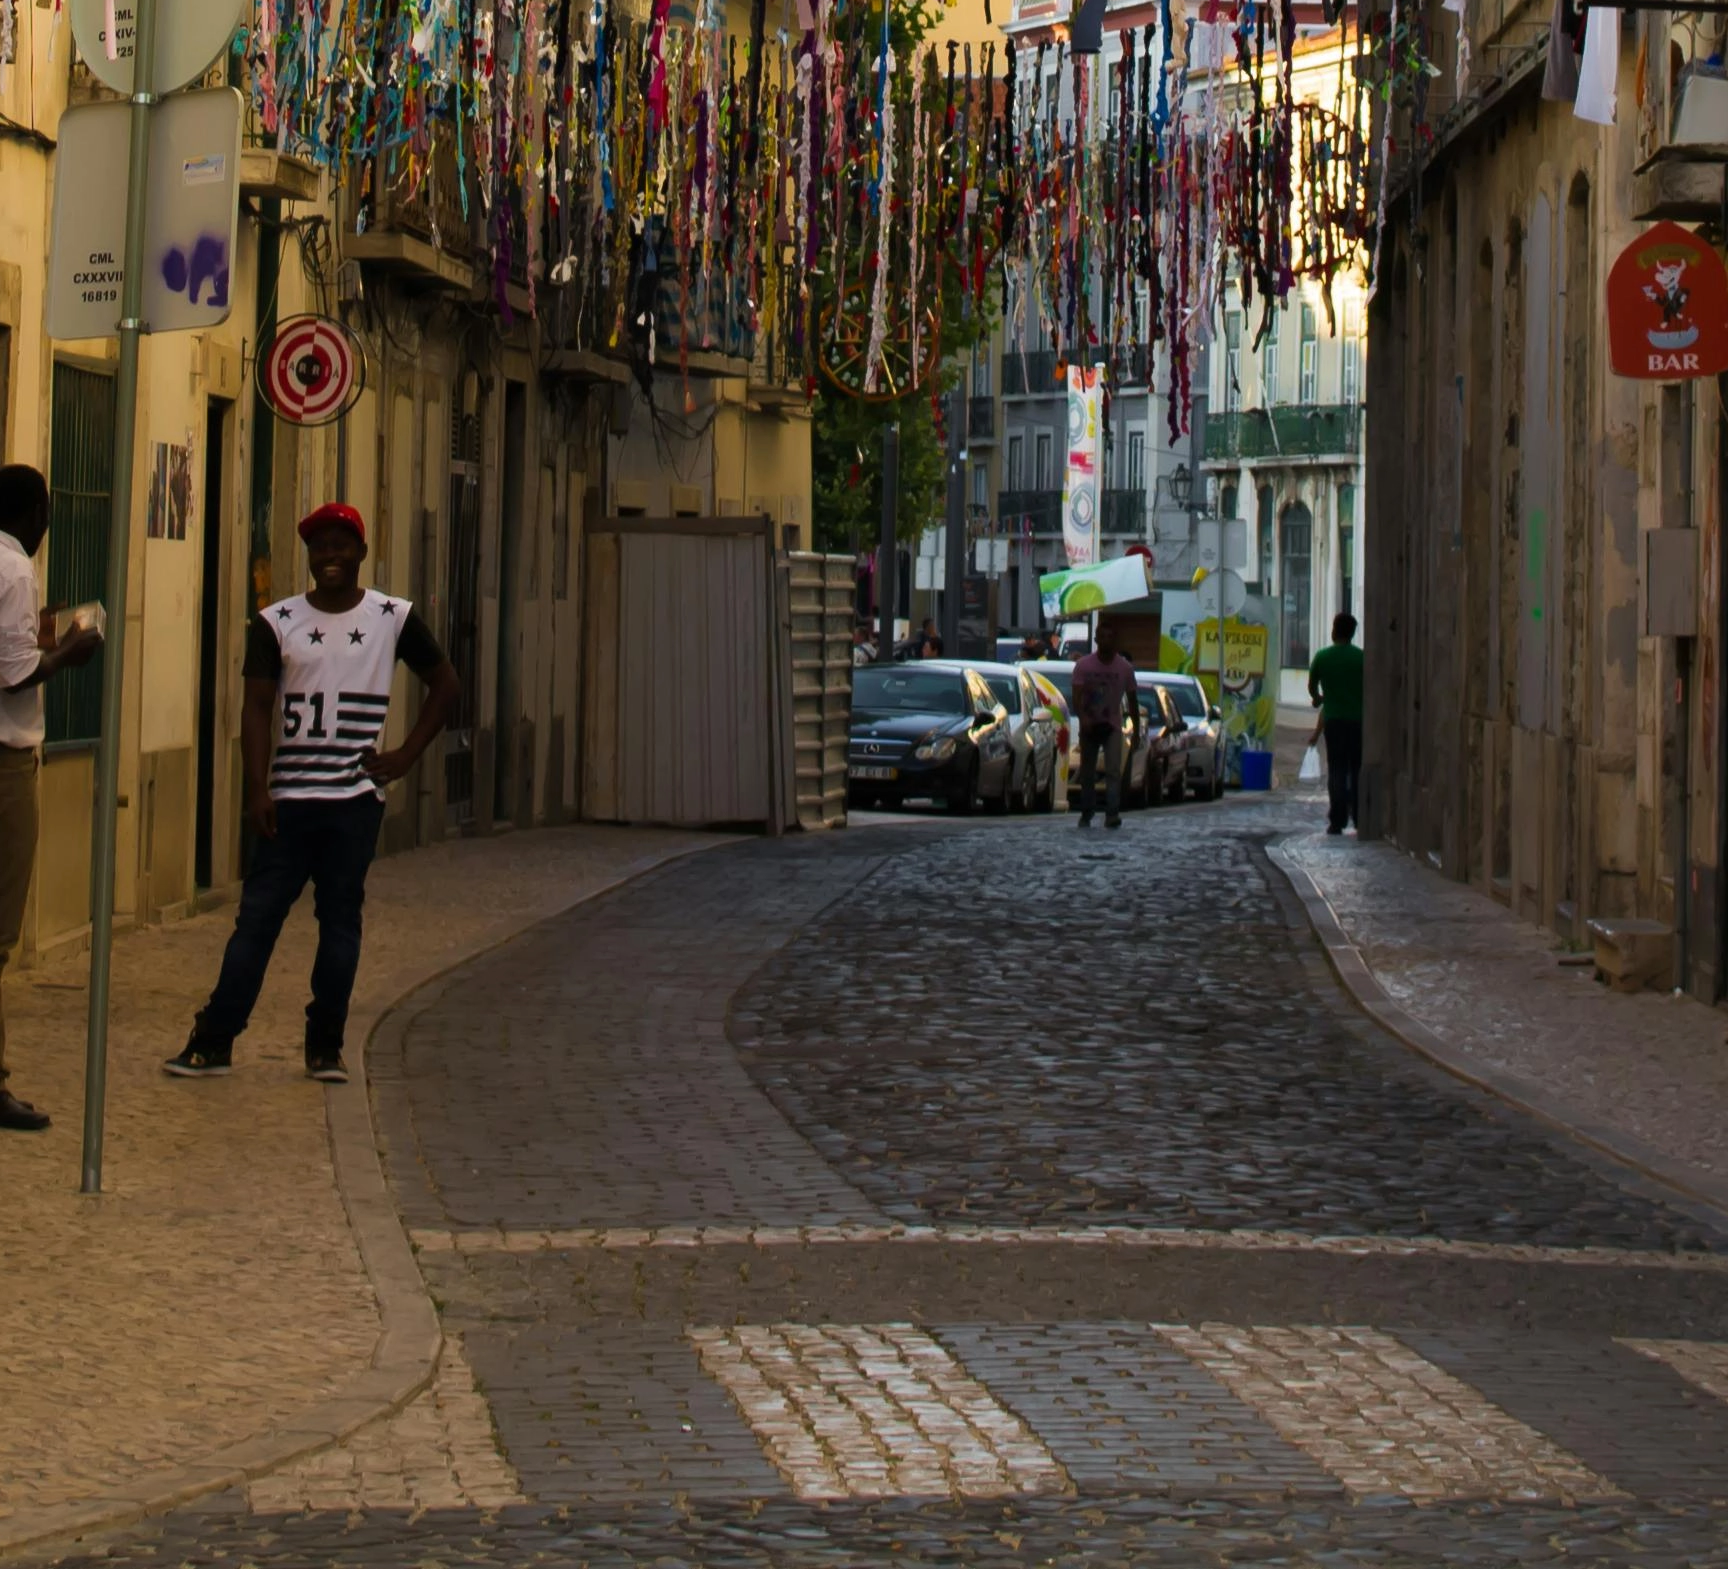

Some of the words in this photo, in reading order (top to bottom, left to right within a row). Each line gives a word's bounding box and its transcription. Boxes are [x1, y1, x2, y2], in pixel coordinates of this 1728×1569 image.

[89, 253, 114, 265] CML
[82, 290, 117, 303] 16819
[1647, 353, 1700, 371] BAR
[283, 691, 327, 739] 51
